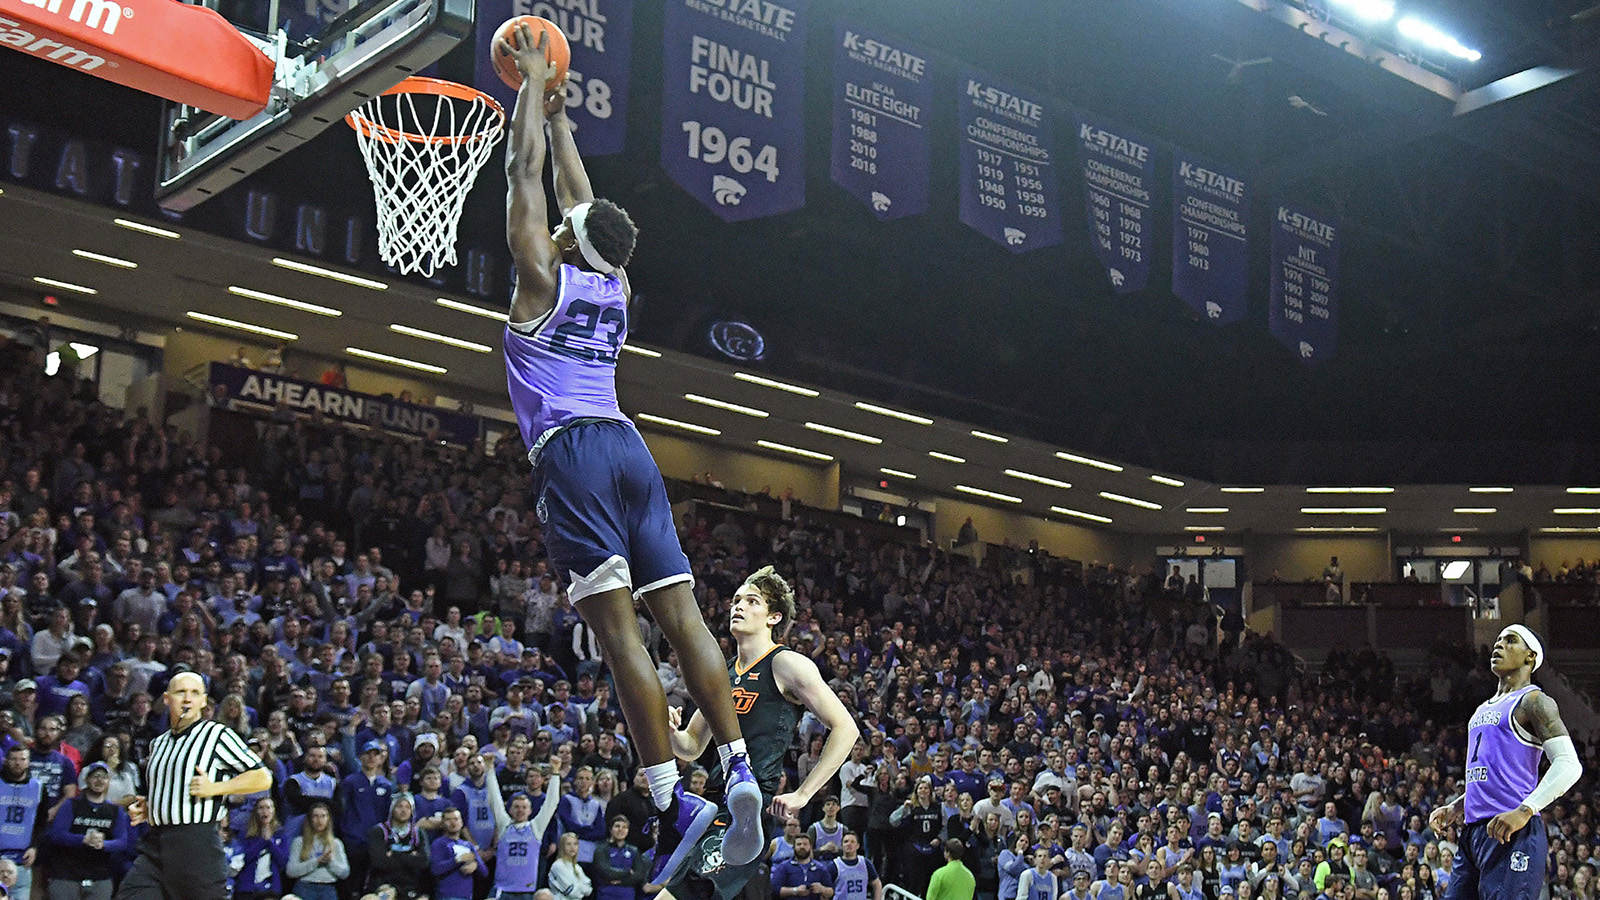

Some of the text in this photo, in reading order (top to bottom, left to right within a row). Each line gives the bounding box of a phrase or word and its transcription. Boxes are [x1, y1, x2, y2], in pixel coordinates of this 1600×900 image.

[691, 34, 776, 90] FINAL
[843, 30, 926, 76] K-STATE
[564, 69, 612, 119] 58
[689, 64, 773, 118] FOUR
[966, 79, 1043, 121] K-STATE
[845, 83, 920, 121] ELITE EIGHT
[851, 108, 877, 127] 1981
[850, 123, 877, 144] 1988
[975, 116, 1039, 147] CONFERENCE
[850, 139, 877, 160] 2010
[967, 124, 1049, 159] CHAMPIONSHIPS
[1080, 122, 1149, 163] K-STATE
[682, 121, 779, 183] 1964
[977, 149, 1002, 166] 1917
[850, 155, 877, 176] 2018
[978, 163, 1004, 181] 1919
[1013, 161, 1039, 177] 1951
[1087, 158, 1142, 189] CONFERENCE
[979, 179, 1005, 196] 1948
[1014, 175, 1043, 191] 1956
[1179, 160, 1245, 197] K-STATE
[979, 193, 1006, 211] 1950
[1016, 190, 1045, 204] 1958
[1018, 204, 1047, 218] 1959
[1119, 202, 1141, 220] 1968
[1186, 195, 1240, 222] CONFERENCE
[1119, 217, 1142, 234] 1970
[1180, 203, 1246, 235] CHAMPIONSHIPS
[1277, 206, 1336, 242] K-STATE
[1120, 231, 1142, 248] 1972
[1188, 226, 1209, 243] 1977
[1120, 245, 1142, 263] 1973
[1189, 240, 1210, 257] 1980
[1298, 244, 1316, 263] NIT
[1188, 254, 1210, 271] 2013
[548, 298, 625, 364] 23
[1470, 731, 1483, 764] 1
[5, 805, 25, 824] 18
[476, 806, 489, 821] 18
[509, 841, 528, 858] 25
[846, 879, 863, 894] 25
